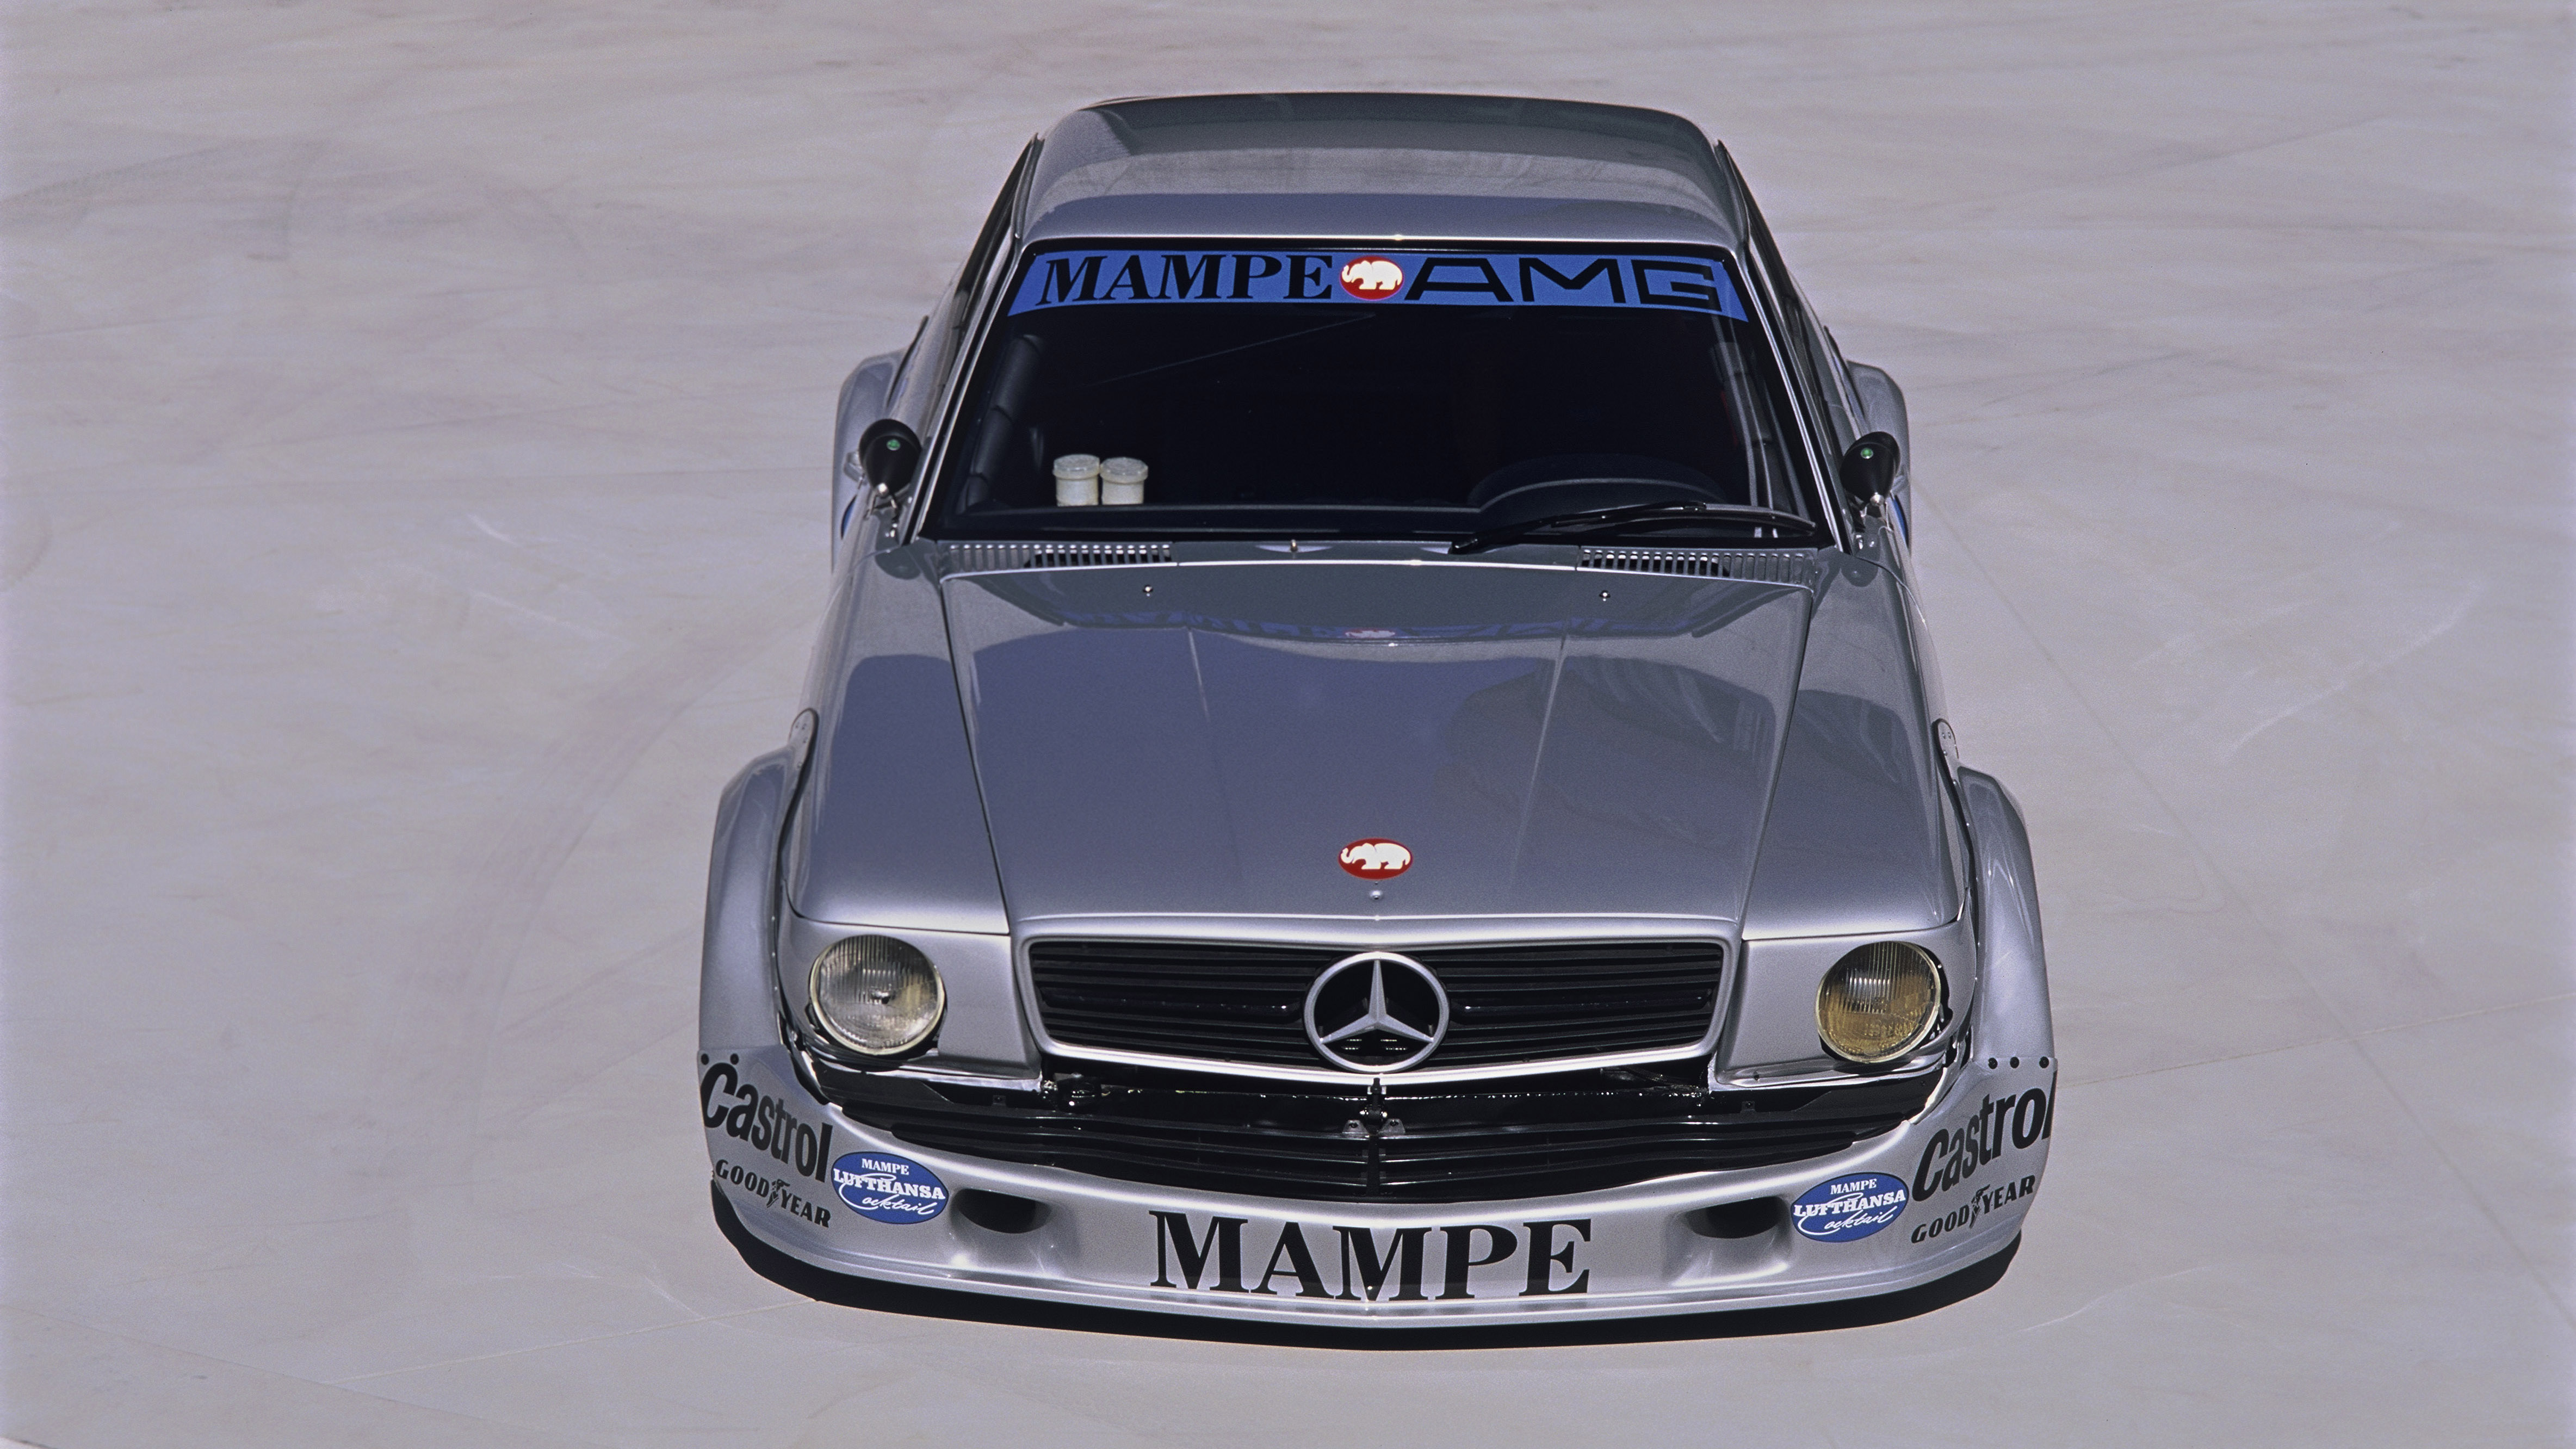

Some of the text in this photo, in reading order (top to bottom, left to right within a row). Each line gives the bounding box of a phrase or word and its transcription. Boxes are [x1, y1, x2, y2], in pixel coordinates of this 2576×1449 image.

[1037, 254, 1722, 312] MAMPE AMG
[700, 1062, 833, 1183] Castrol
[862, 1158, 909, 1175] MAMPE
[833, 1168, 946, 1200] LUFTHANSA
[1830, 1179, 1877, 1195] MAMPE
[1793, 1189, 1906, 1217] LUFTHANSA
[1149, 1210, 1592, 1302] MAMPE
